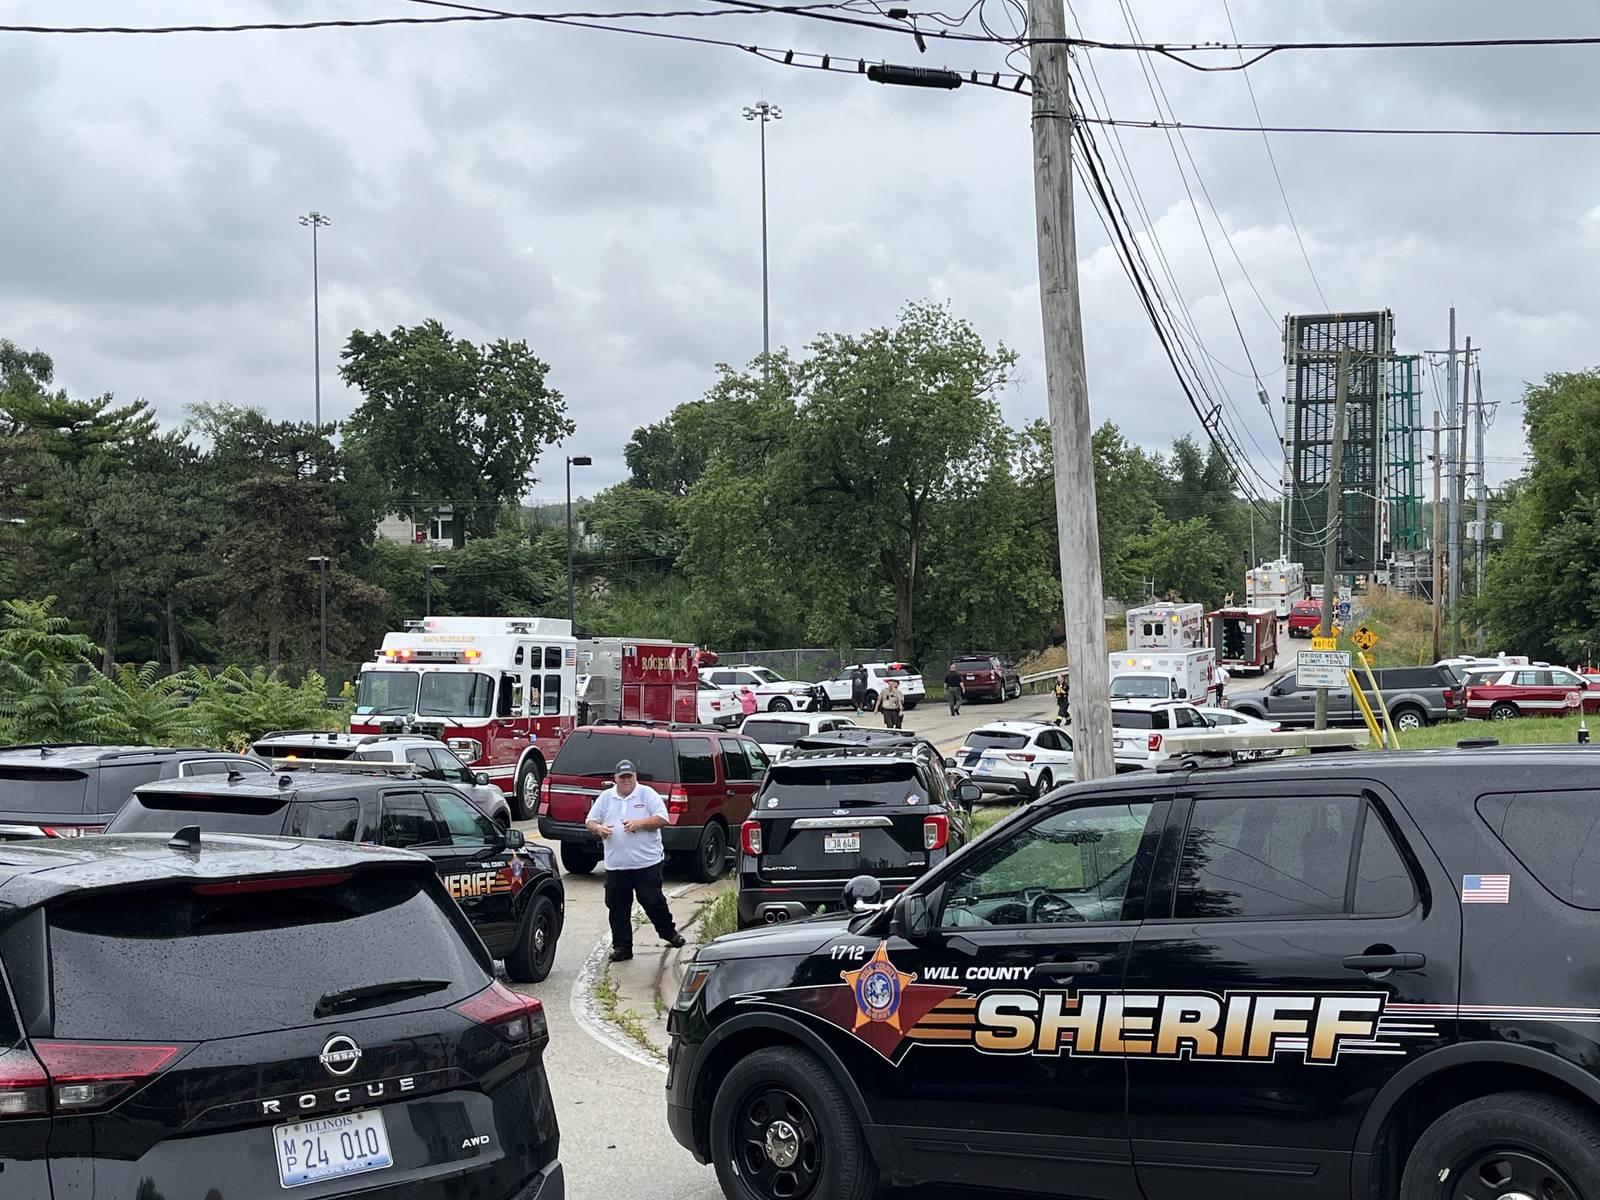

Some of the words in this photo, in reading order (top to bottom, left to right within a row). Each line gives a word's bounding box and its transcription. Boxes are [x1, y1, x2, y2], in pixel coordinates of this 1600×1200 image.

[1324, 652, 1348, 660] WEIGHT
[830, 945, 865, 960] 1712
[923, 966, 960, 980] WILL
[965, 966, 1035, 980] COUNTY
[976, 993, 1381, 1060] SHERIFF
[319, 1048, 363, 1063] NISSAN
[262, 1077, 416, 1115] ROGUE
[304, 1116, 354, 1134] ILLINOIS
[302, 1136, 330, 1169] 24
[340, 1126, 380, 1161] 010
[461, 1134, 490, 1148] AWD
[308, 1166, 342, 1179] MUNICIPAL
[344, 1161, 367, 1172] POLICE
